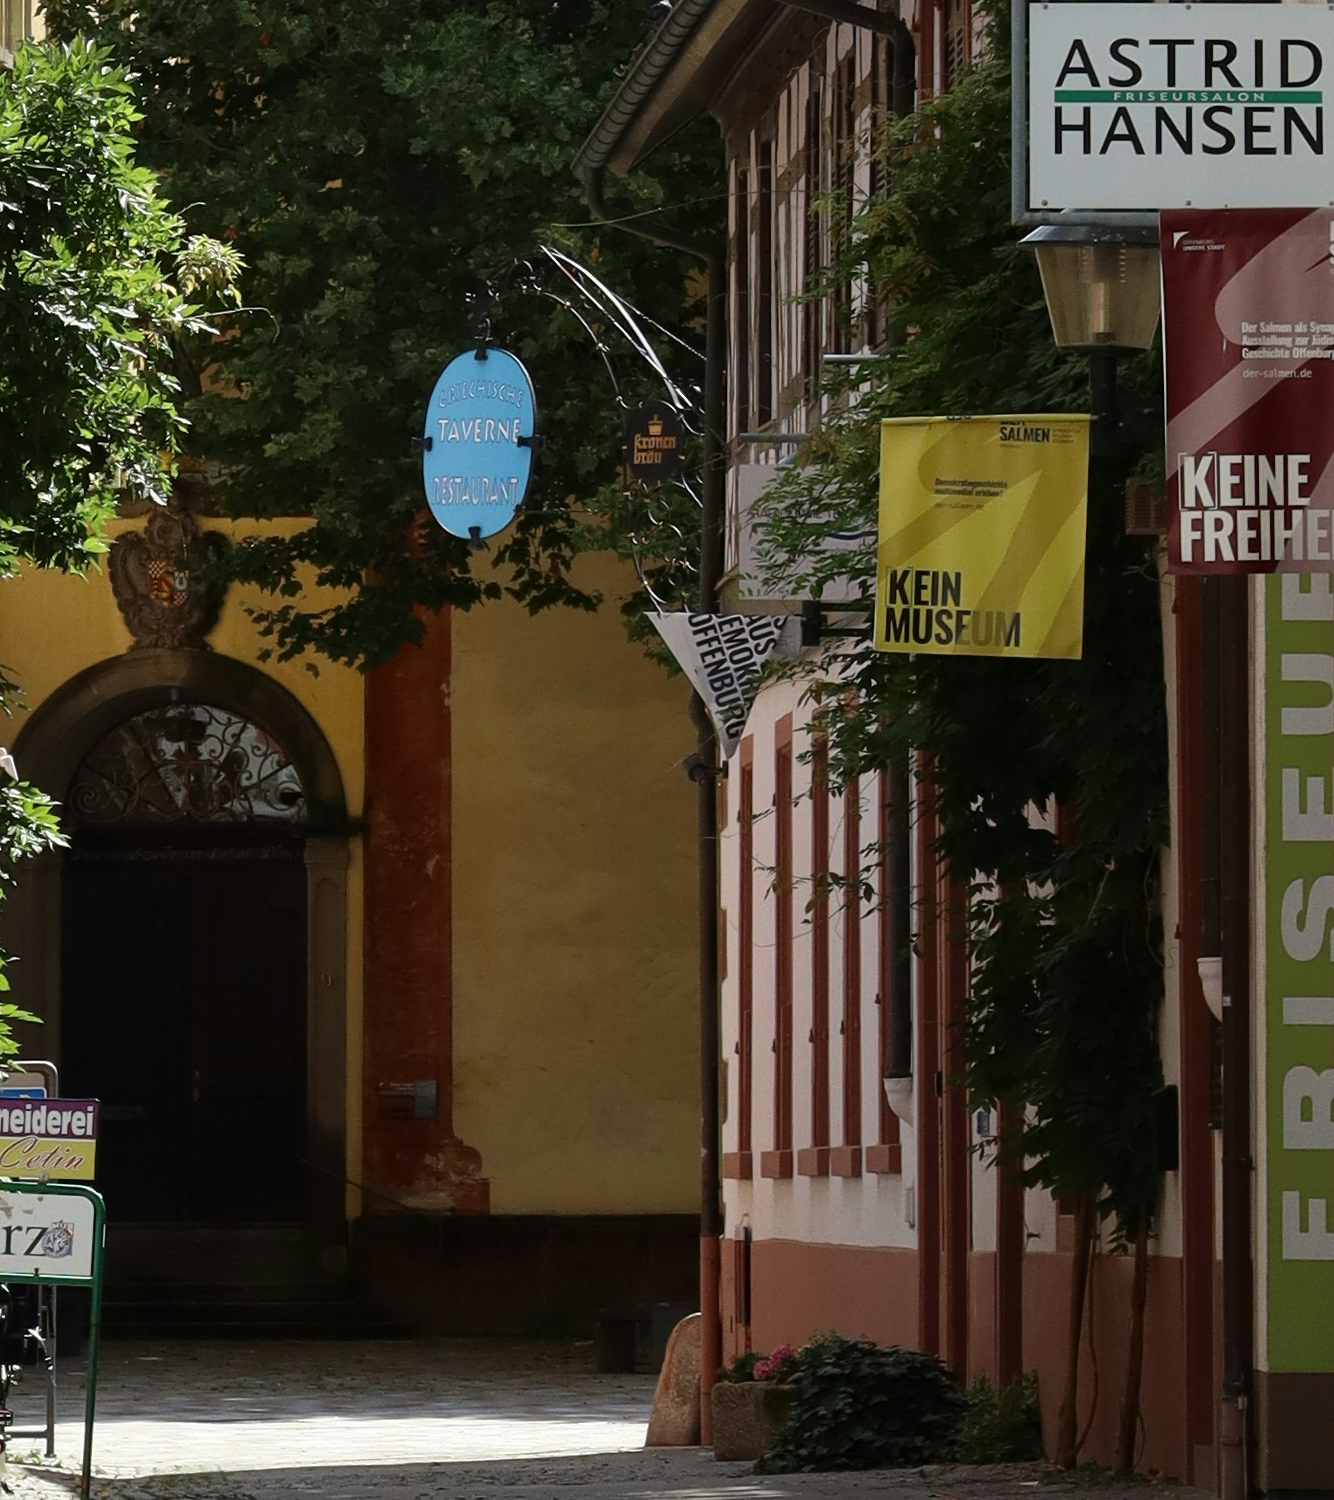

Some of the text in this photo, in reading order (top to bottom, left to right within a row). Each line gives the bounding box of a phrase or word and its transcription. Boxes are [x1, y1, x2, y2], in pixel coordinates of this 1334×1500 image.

[1055, 38, 1323, 88] ASTRID
[1113, 91, 1265, 102] FRISEURSALON
[1054, 105, 1324, 155] HANSEN
[438, 379, 524, 408] GRIECHISCHE
[438, 418, 521, 443] TAVERNE
[999, 426, 1051, 443] SALMEN
[432, 476, 519, 506] RESTAURANT
[884, 607, 1021, 648] MUSEUM
